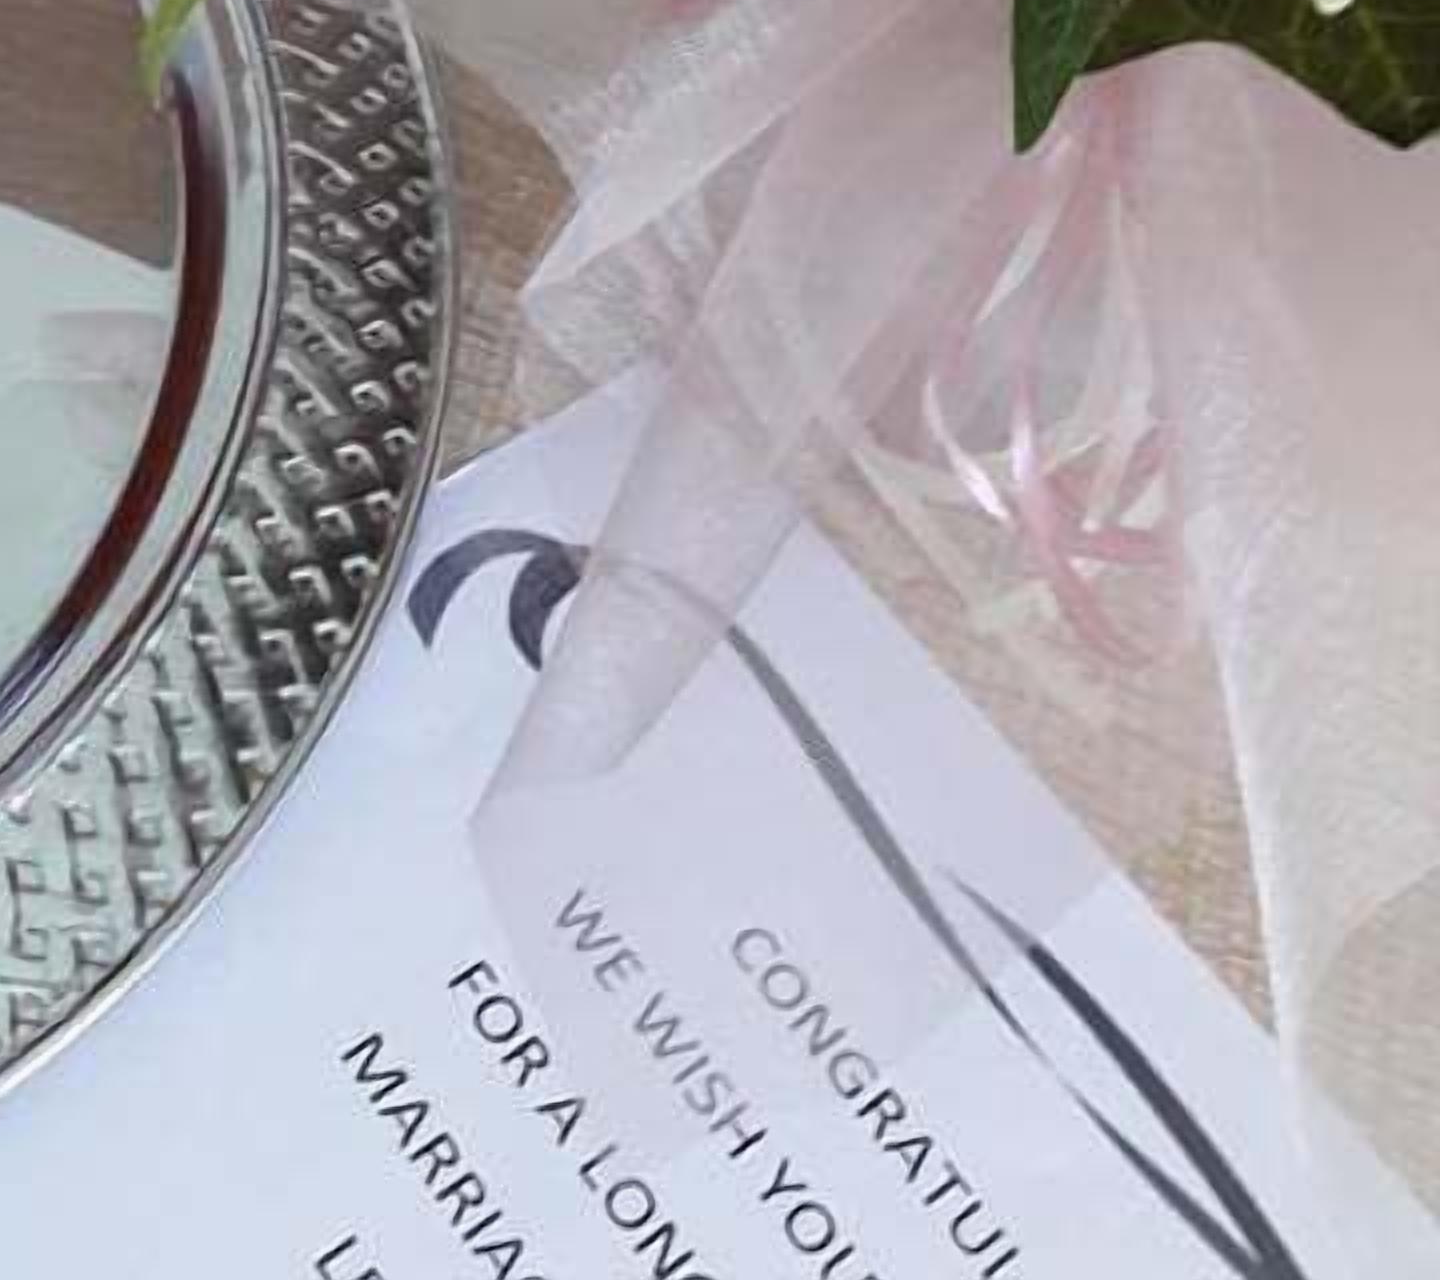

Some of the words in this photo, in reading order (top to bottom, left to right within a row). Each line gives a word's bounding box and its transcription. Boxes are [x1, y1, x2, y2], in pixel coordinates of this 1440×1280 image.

[339, 1032, 544, 1280] MARRIA
[447, 960, 550, 1086] FOR
[532, 1097, 585, 1146] A
[578, 1143, 716, 1280] LON
[556, 888, 645, 991] WE
[633, 991, 768, 1159] WISH
